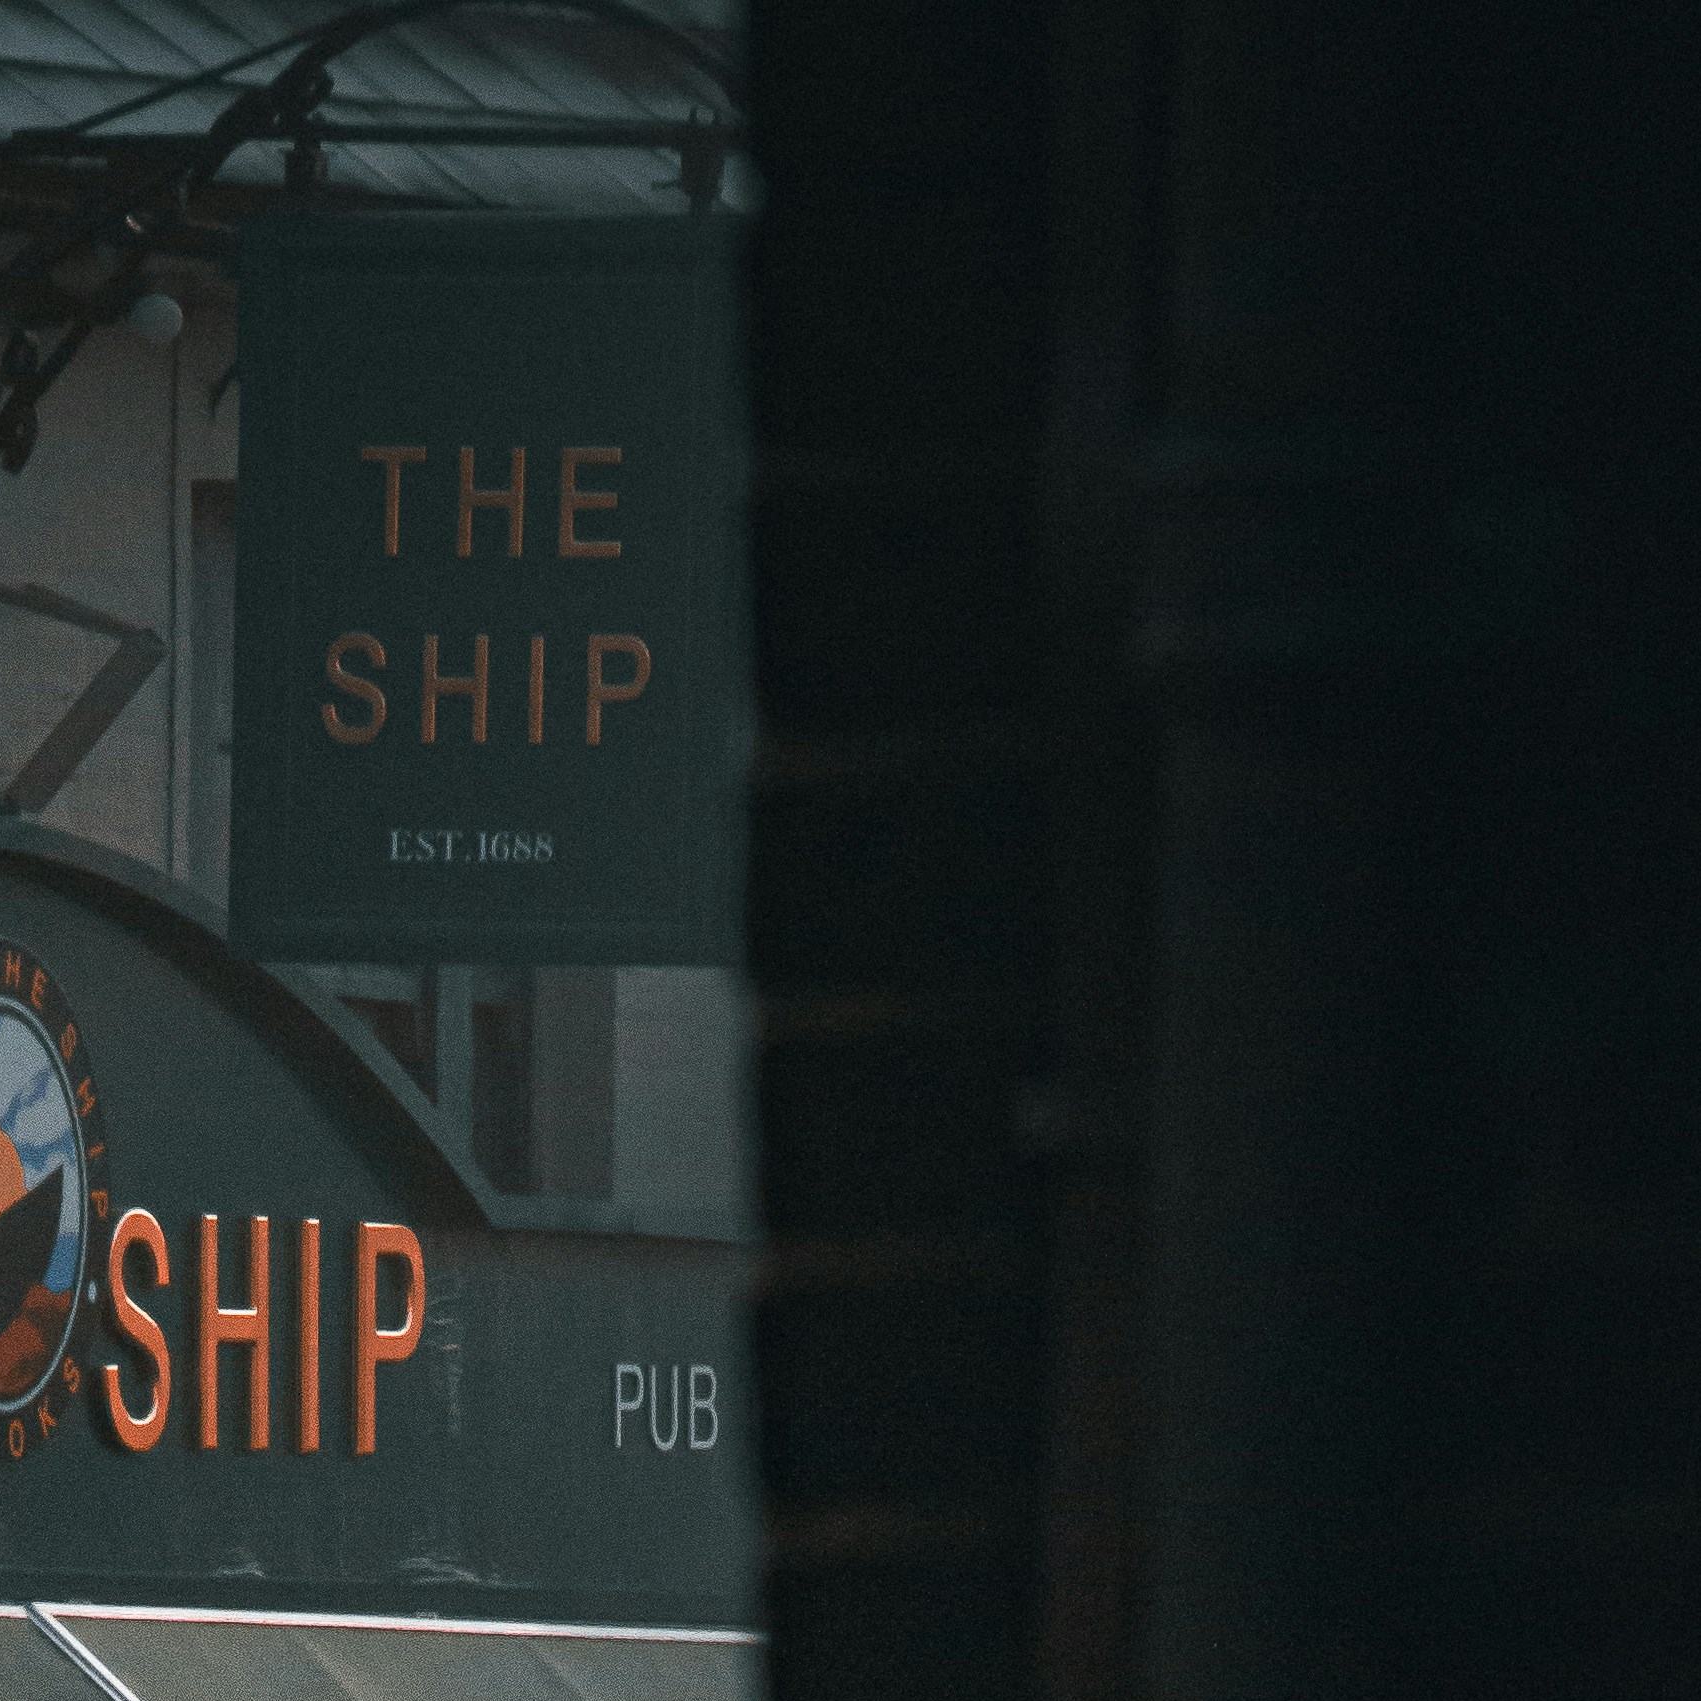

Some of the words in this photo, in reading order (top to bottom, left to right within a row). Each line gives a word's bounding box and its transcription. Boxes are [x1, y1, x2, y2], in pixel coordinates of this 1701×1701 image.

[361, 446, 623, 558] THE
[321, 632, 652, 745] SHIP
[389, 828, 554, 864] EST.1688
[58, 1021, 111, 1220] SHIP
[102, 1206, 427, 1456] SHIP
[615, 1363, 719, 1451] PUB
